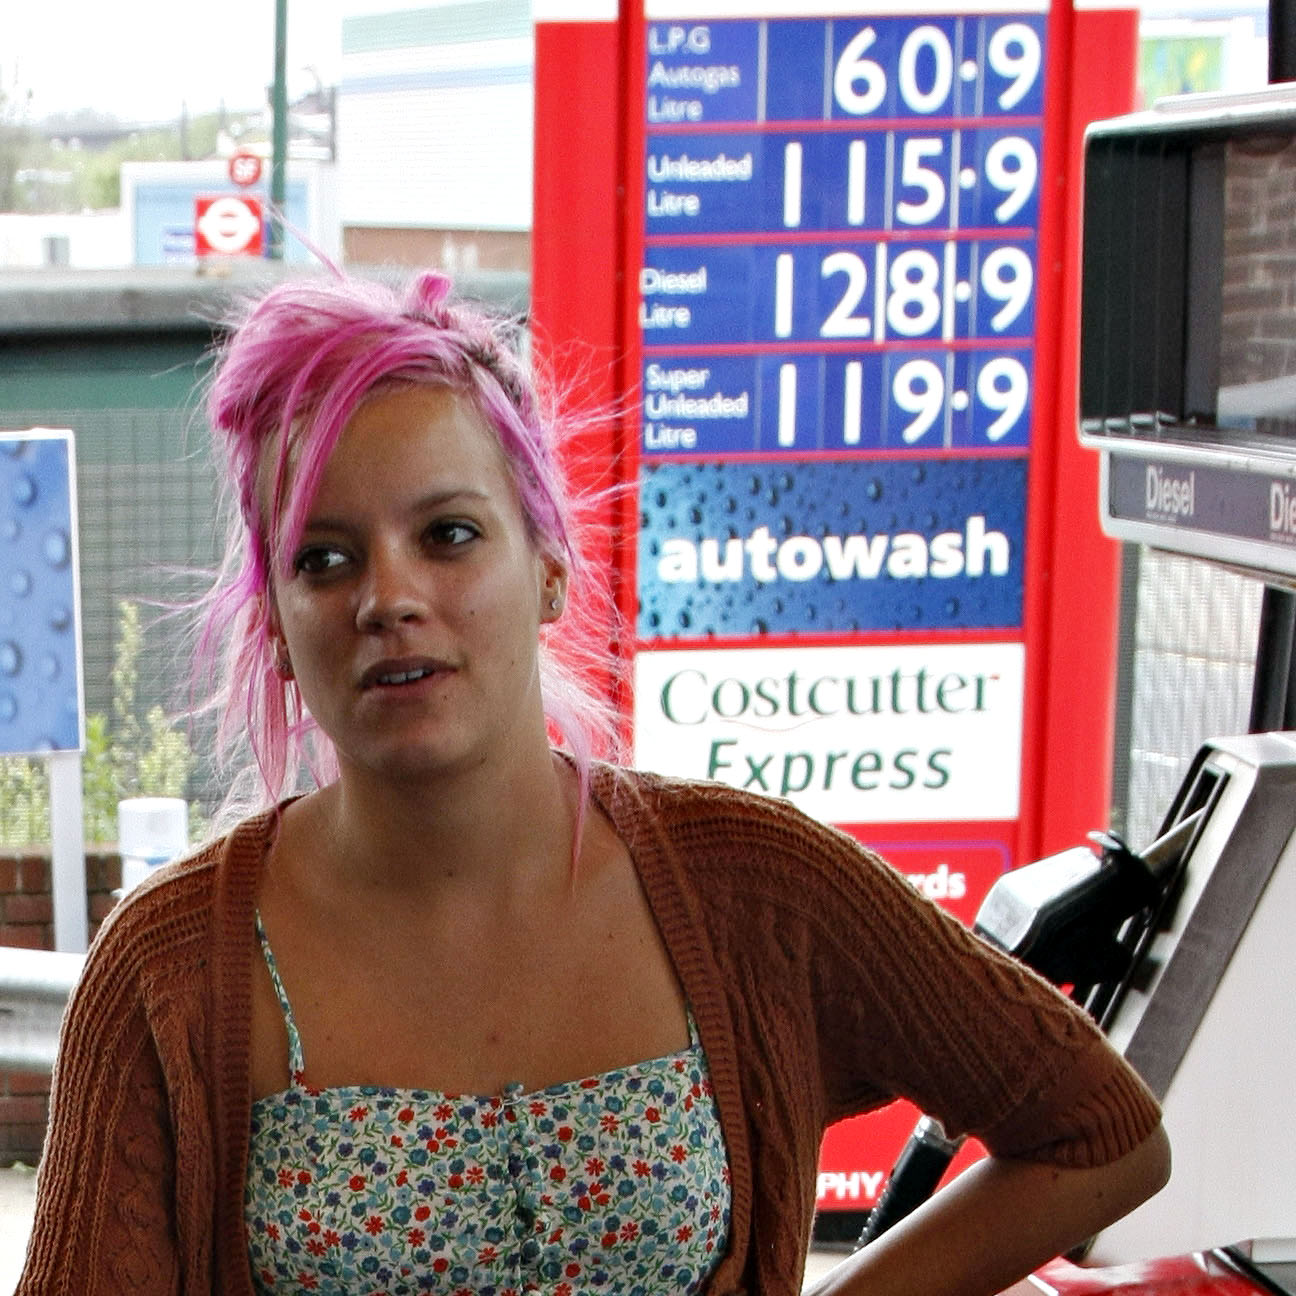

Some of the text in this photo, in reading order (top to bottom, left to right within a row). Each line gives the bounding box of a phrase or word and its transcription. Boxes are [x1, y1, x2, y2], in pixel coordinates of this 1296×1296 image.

[648, 61, 741, 94] Autogas
[648, 95, 703, 122] Litre
[647, 152, 752, 182] Unleaded
[647, 189, 700, 216] Litre
[639, 266, 707, 295] Diesel
[639, 301, 691, 328] Litre
[646, 363, 710, 396] Super
[645, 391, 748, 420] Unleaded
[645, 422, 697, 450] Litre
[1146, 464, 1195, 516] Diesel
[1270, 481, 1296, 536] Die
[657, 516, 1009, 583] autowash
[661, 667, 996, 725] Costcutter
[707, 739, 953, 798] Express
[816, 1171, 883, 1199] PHY
